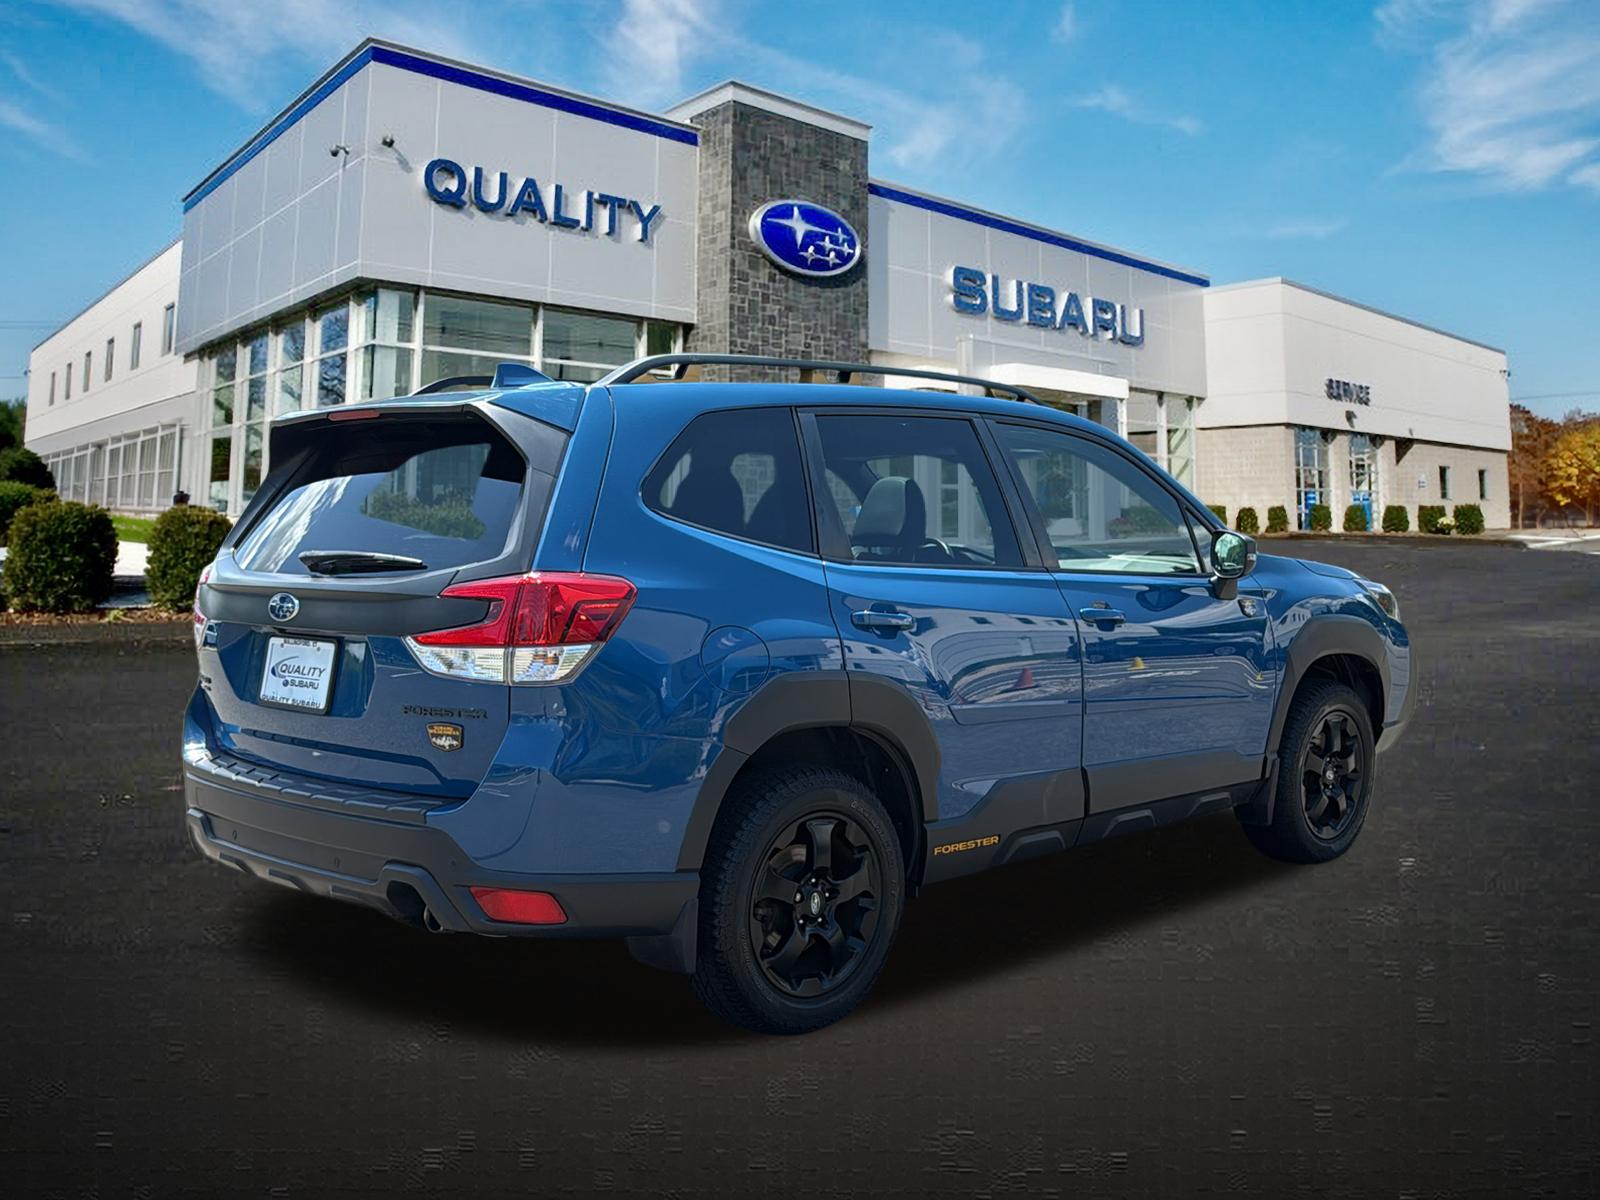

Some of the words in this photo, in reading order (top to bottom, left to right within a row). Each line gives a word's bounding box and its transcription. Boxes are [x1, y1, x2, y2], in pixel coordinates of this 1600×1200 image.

[423, 158, 662, 243] QUALITY
[950, 265, 1145, 347] SUBARU
[1325, 378, 1371, 406] SERVICE
[280, 663, 326, 677] QUALITY
[290, 679, 320, 690] SUBARU
[402, 704, 488, 719] FORESTER
[934, 835, 1000, 856] FORESTER
